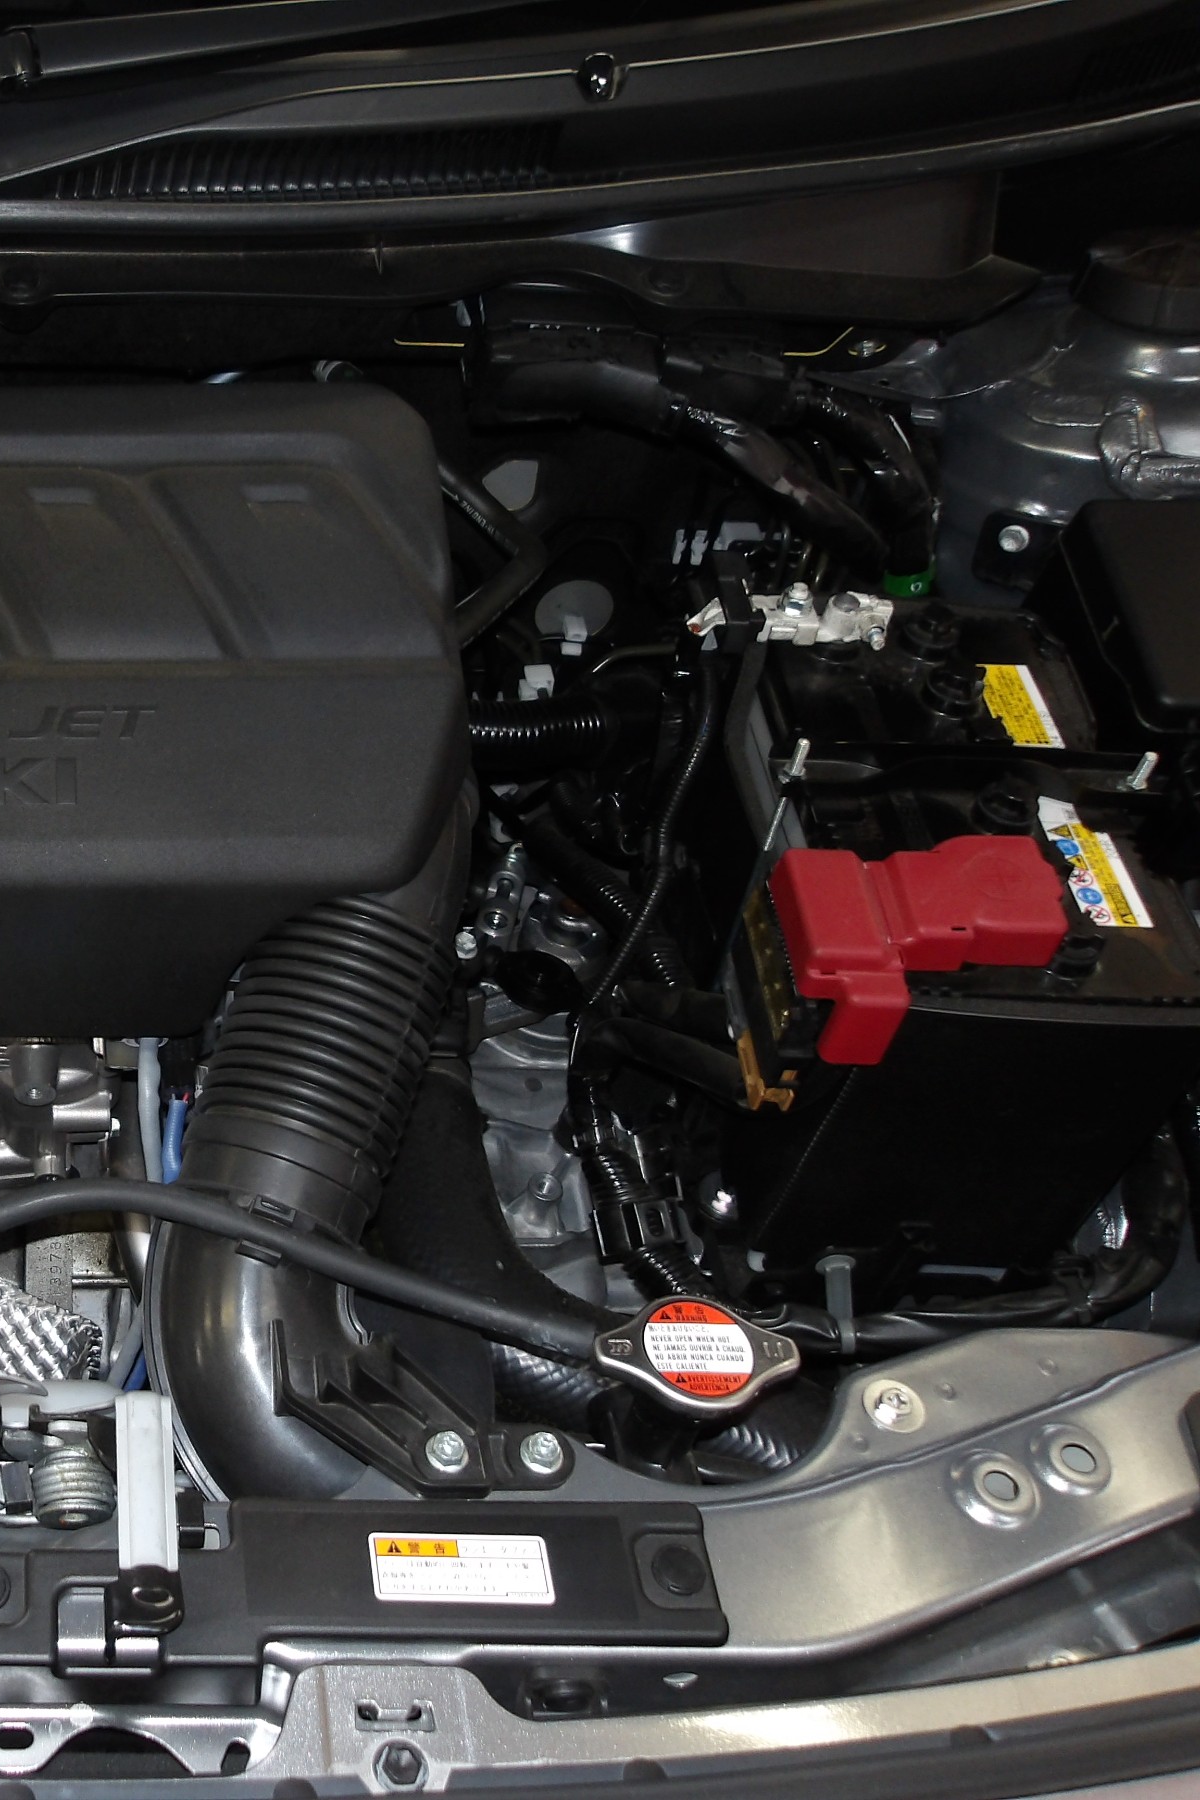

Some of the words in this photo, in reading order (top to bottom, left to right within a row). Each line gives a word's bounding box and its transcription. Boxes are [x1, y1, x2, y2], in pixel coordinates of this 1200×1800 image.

[8, 705, 158, 740] JET
[674, 1315, 708, 1323] WARNING
[650, 1334, 672, 1343] NEVER
[674, 1335, 693, 1343] OPEN
[696, 1335, 715, 1343] WHEN
[717, 1335, 731, 1344] HOT
[652, 1344, 661, 1352] NE
[663, 1343, 687, 1352] JAMAIS
[689, 1344, 714, 1353] OUVRIR
[654, 1353, 664, 1361] NO
[667, 1353, 688, 1361] ABRIR
[690, 1353, 714, 1362] NUNCA
[716, 1354, 745, 1363] CUANDO
[657, 1362, 673, 1370] ESTE
[676, 1362, 708, 1371] CALIENTE
[687, 1375, 742, 1384] AVERTISSEMENT
[689, 1383, 730, 1392] ADVERTENCIA
